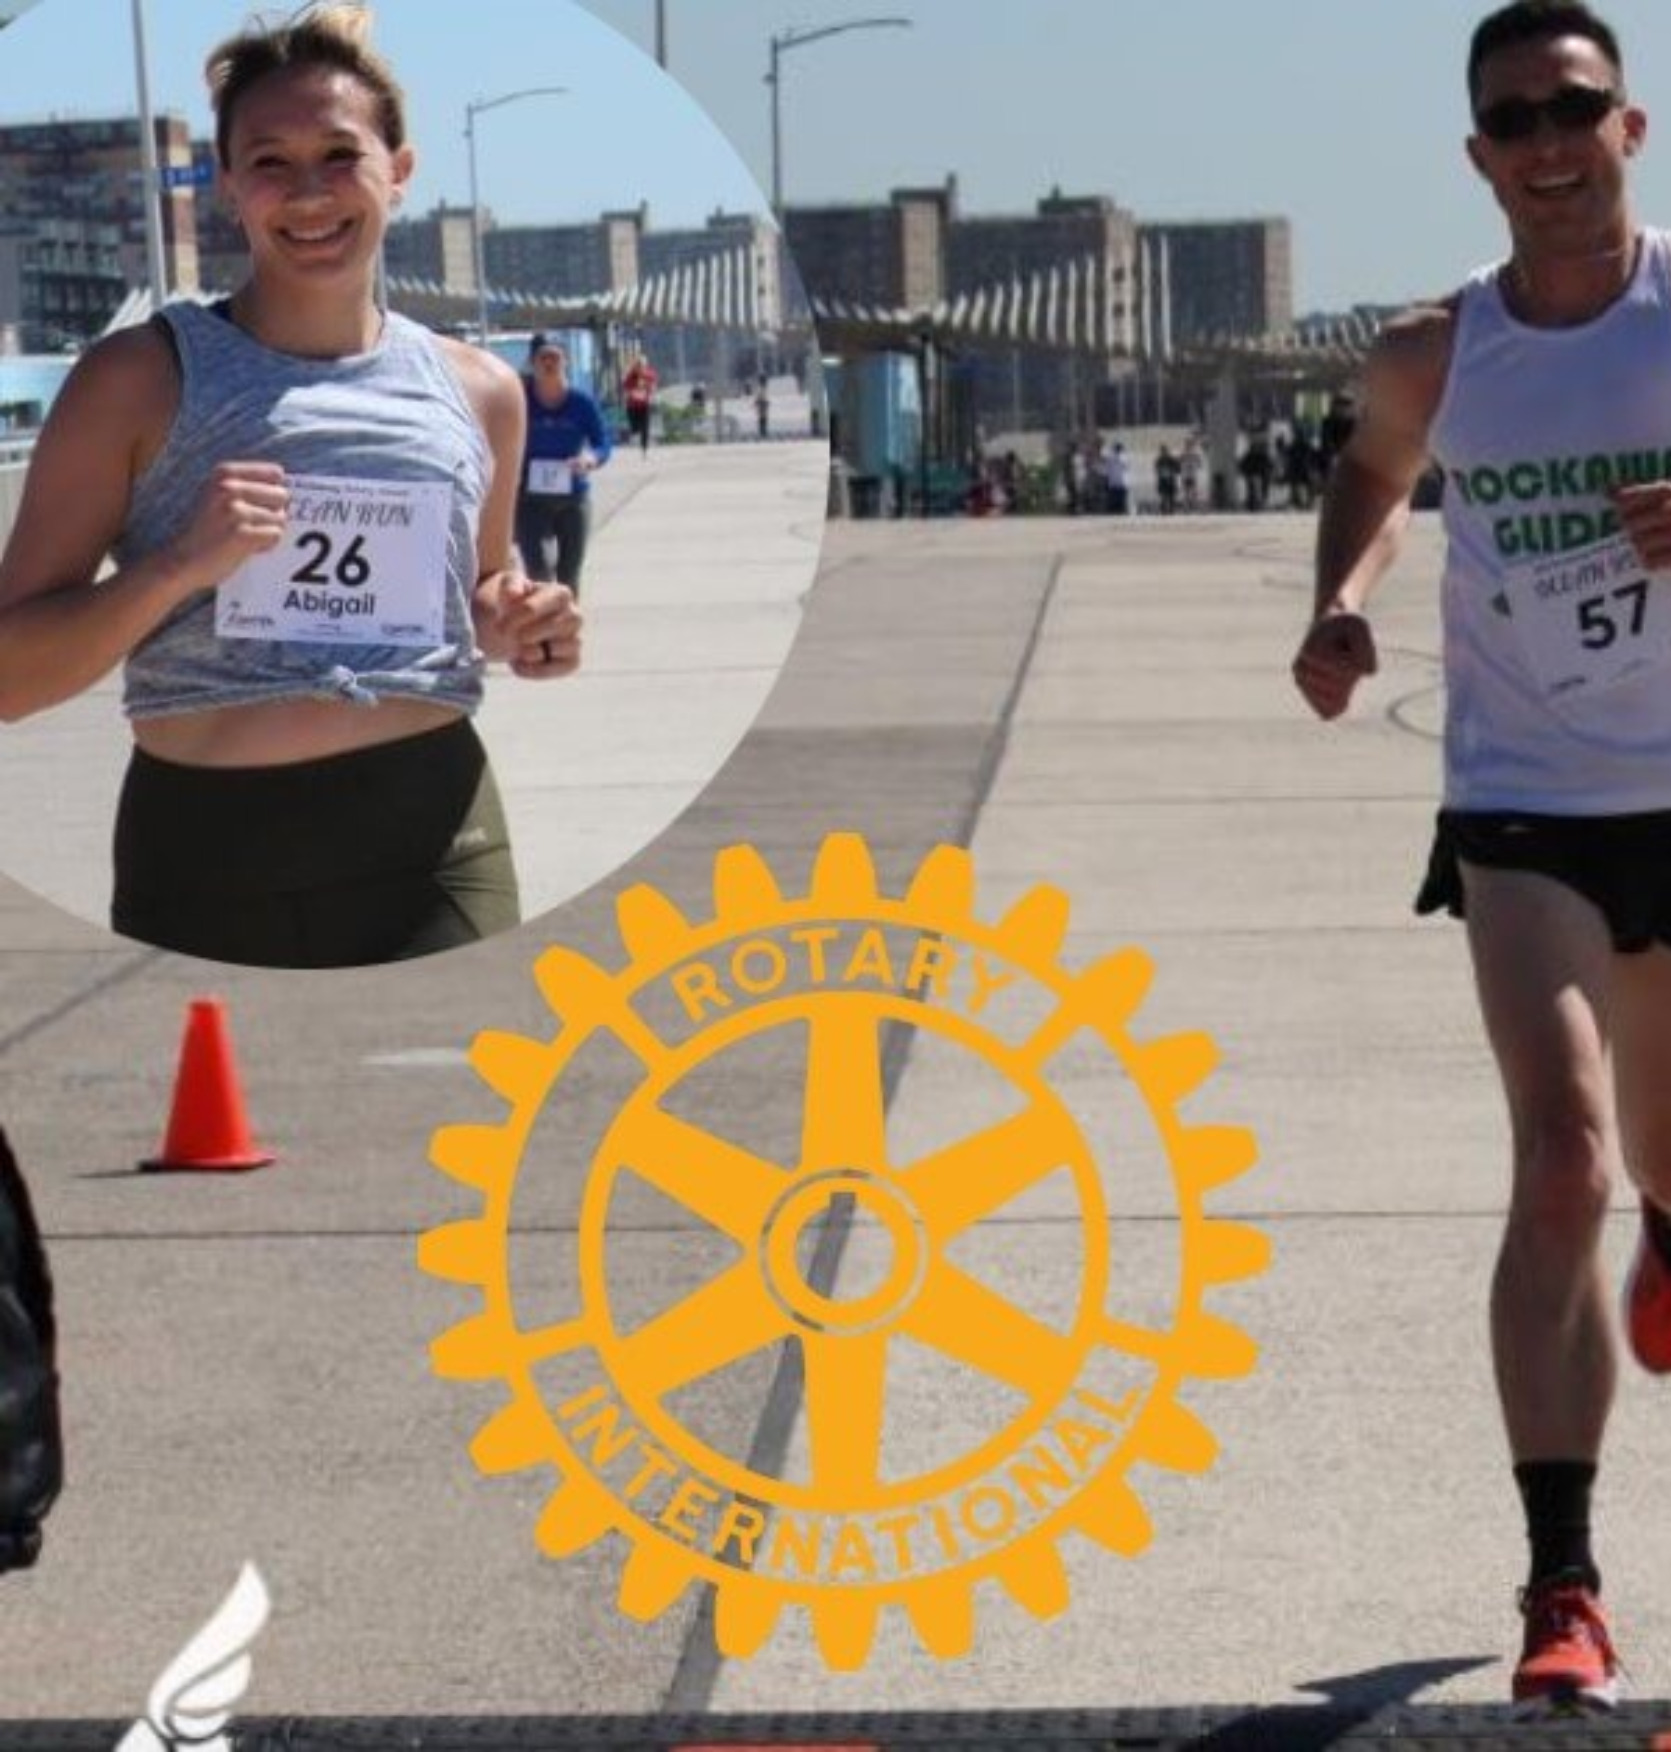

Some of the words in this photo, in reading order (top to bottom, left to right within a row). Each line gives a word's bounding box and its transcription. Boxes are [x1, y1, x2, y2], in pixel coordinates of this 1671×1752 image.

[287, 497, 352, 525] EAN
[290, 531, 371, 587] 26
[283, 589, 376, 619] Abigail
[1576, 580, 1650, 651] 57
